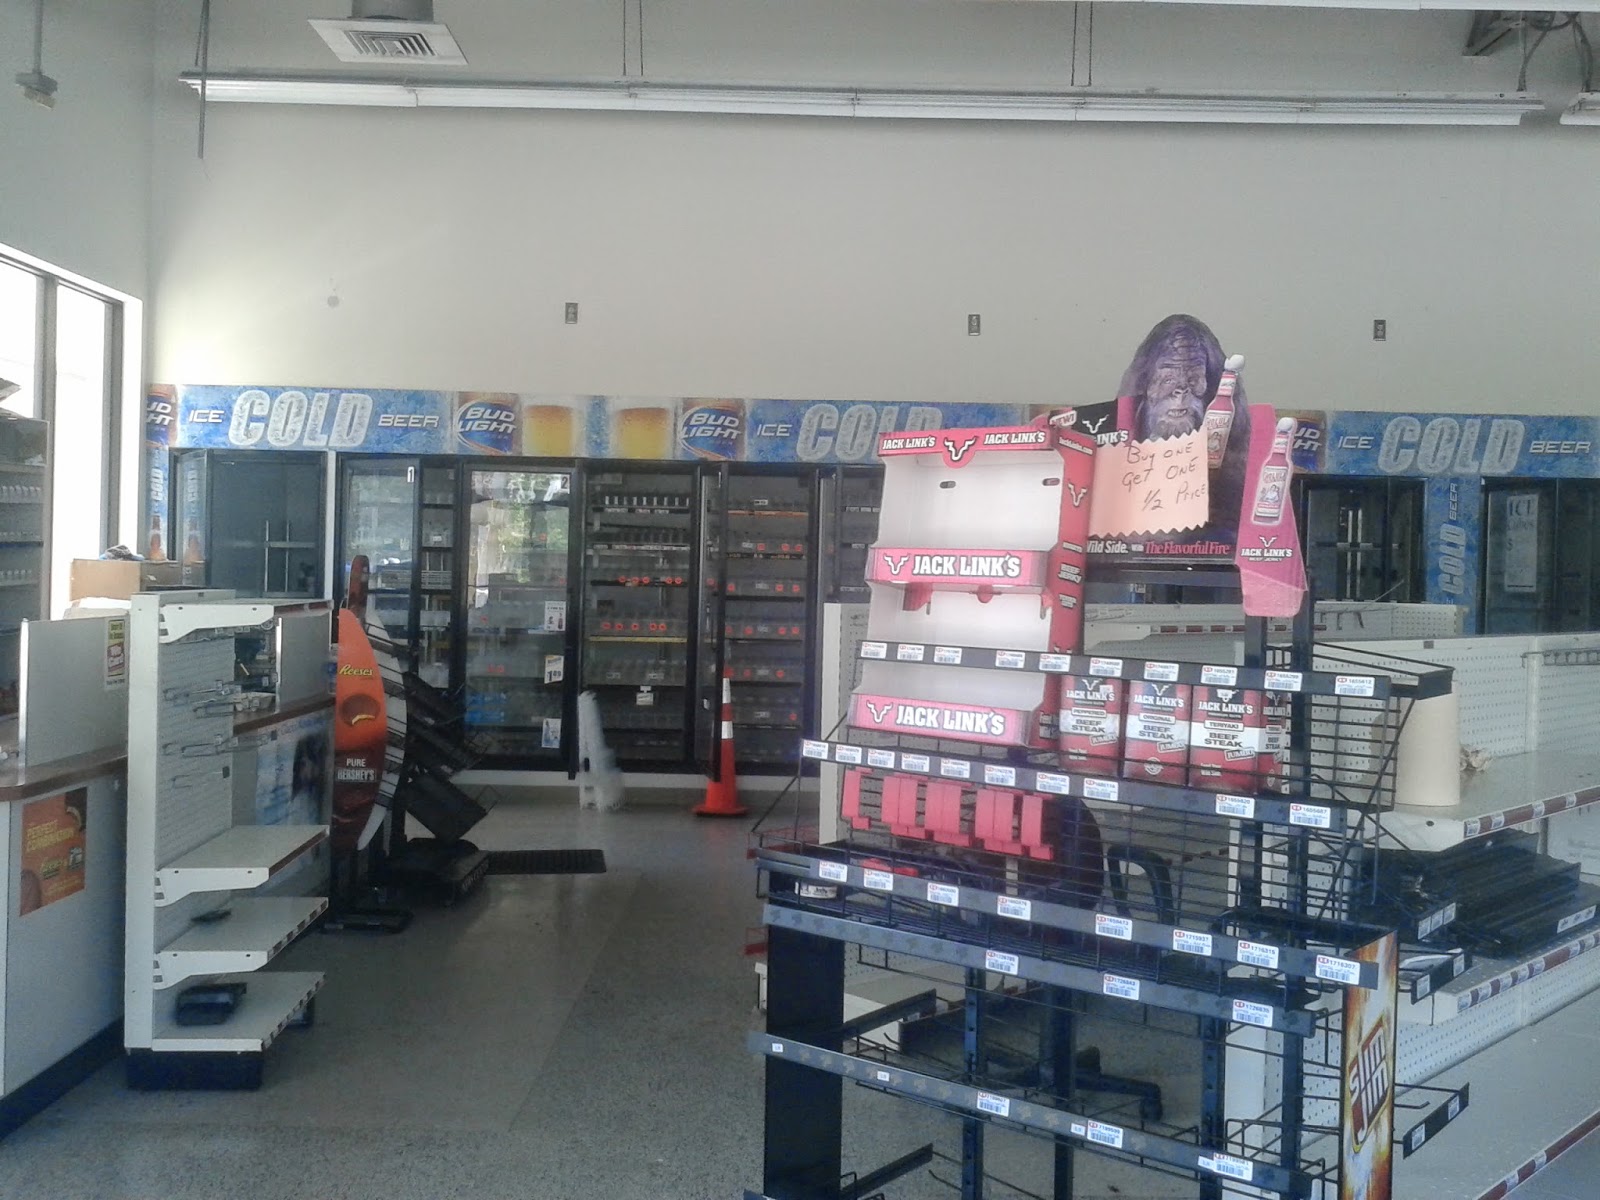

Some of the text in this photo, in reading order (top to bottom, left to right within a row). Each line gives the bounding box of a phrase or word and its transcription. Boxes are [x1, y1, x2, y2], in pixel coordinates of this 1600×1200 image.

[147, 402, 172, 413] UD
[465, 407, 515, 421] BUD
[188, 409, 224, 422] ICE
[228, 391, 373, 446] COLD
[378, 414, 439, 428] BEER
[690, 413, 739, 427] BUD
[459, 420, 516, 433] LIGHT
[682, 426, 742, 439] LIGHT
[757, 424, 792, 436] ICE
[1295, 427, 1320, 439] UD
[882, 435, 936, 450] JACK LINK'S
[984, 431, 1045, 445] JACK LINK'S
[1097, 430, 1128, 445] INK'S
[1338, 416, 1591, 474] ICE COLD BEER
[561, 476, 568, 489] 2
[1449, 482, 1458, 520] BEER
[1105, 541, 1128, 553] Side.
[1145, 541, 1164, 554] The
[1241, 548, 1293, 557] JACK LINK'S
[913, 554, 1021, 577] JACK LINK'S
[1438, 523, 1466, 595] COLD
[1066, 689, 1115, 702] JACK LINK'S
[1134, 694, 1185, 707] JACK LINK'S
[1199, 701, 1253, 714] JACK LINK'S
[896, 706, 1005, 736] JACK LINK'S
[1076, 718, 1102, 726] BEEF
[1142, 714, 1171, 722] ORIGINAL
[1072, 724, 1106, 733] STEAK
[1143, 724, 1171, 733] BEEF
[1209, 721, 1239, 729] TERIYAKI
[1139, 731, 1175, 740] STEAK
[1209, 732, 1239, 740] BEEF
[1204, 738, 1243, 747] STEAK
[346, 758, 367, 767] PURE
[1330, 960, 1356, 970] 1716307
